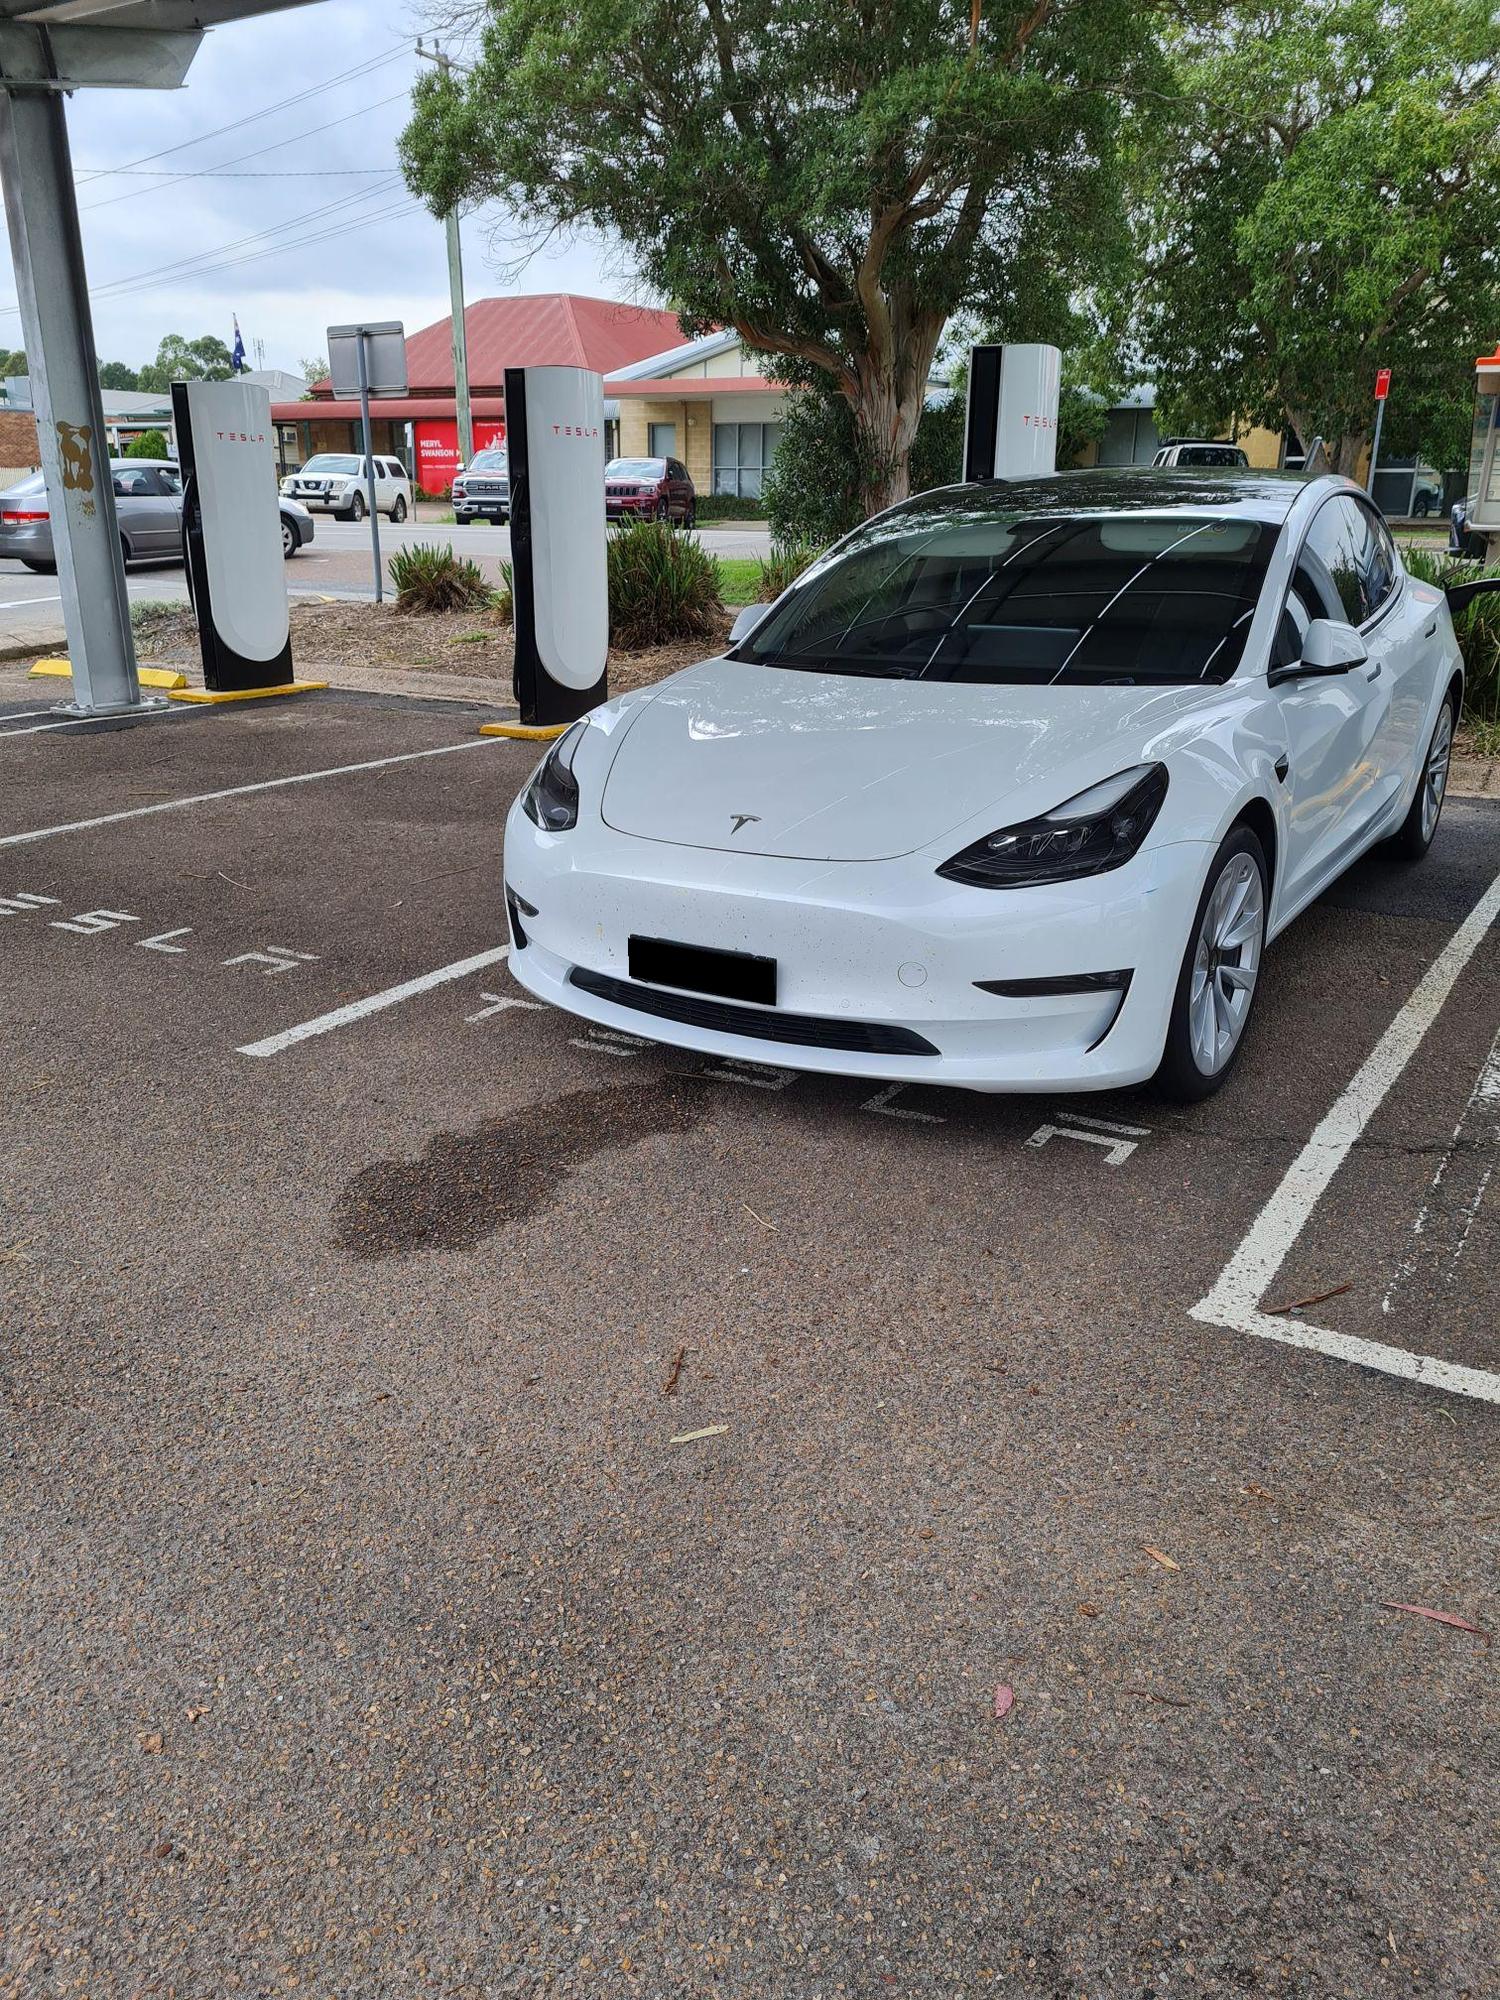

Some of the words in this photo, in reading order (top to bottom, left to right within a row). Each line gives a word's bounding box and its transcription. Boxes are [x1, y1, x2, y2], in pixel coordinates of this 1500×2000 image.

[553, 425, 598, 437] TESLA
[217, 432, 265, 443] TESLA
[420, 440, 442, 448] MERYL
[421, 449, 454, 457] SWANSON
[0, 892, 321, 975] ESLA
